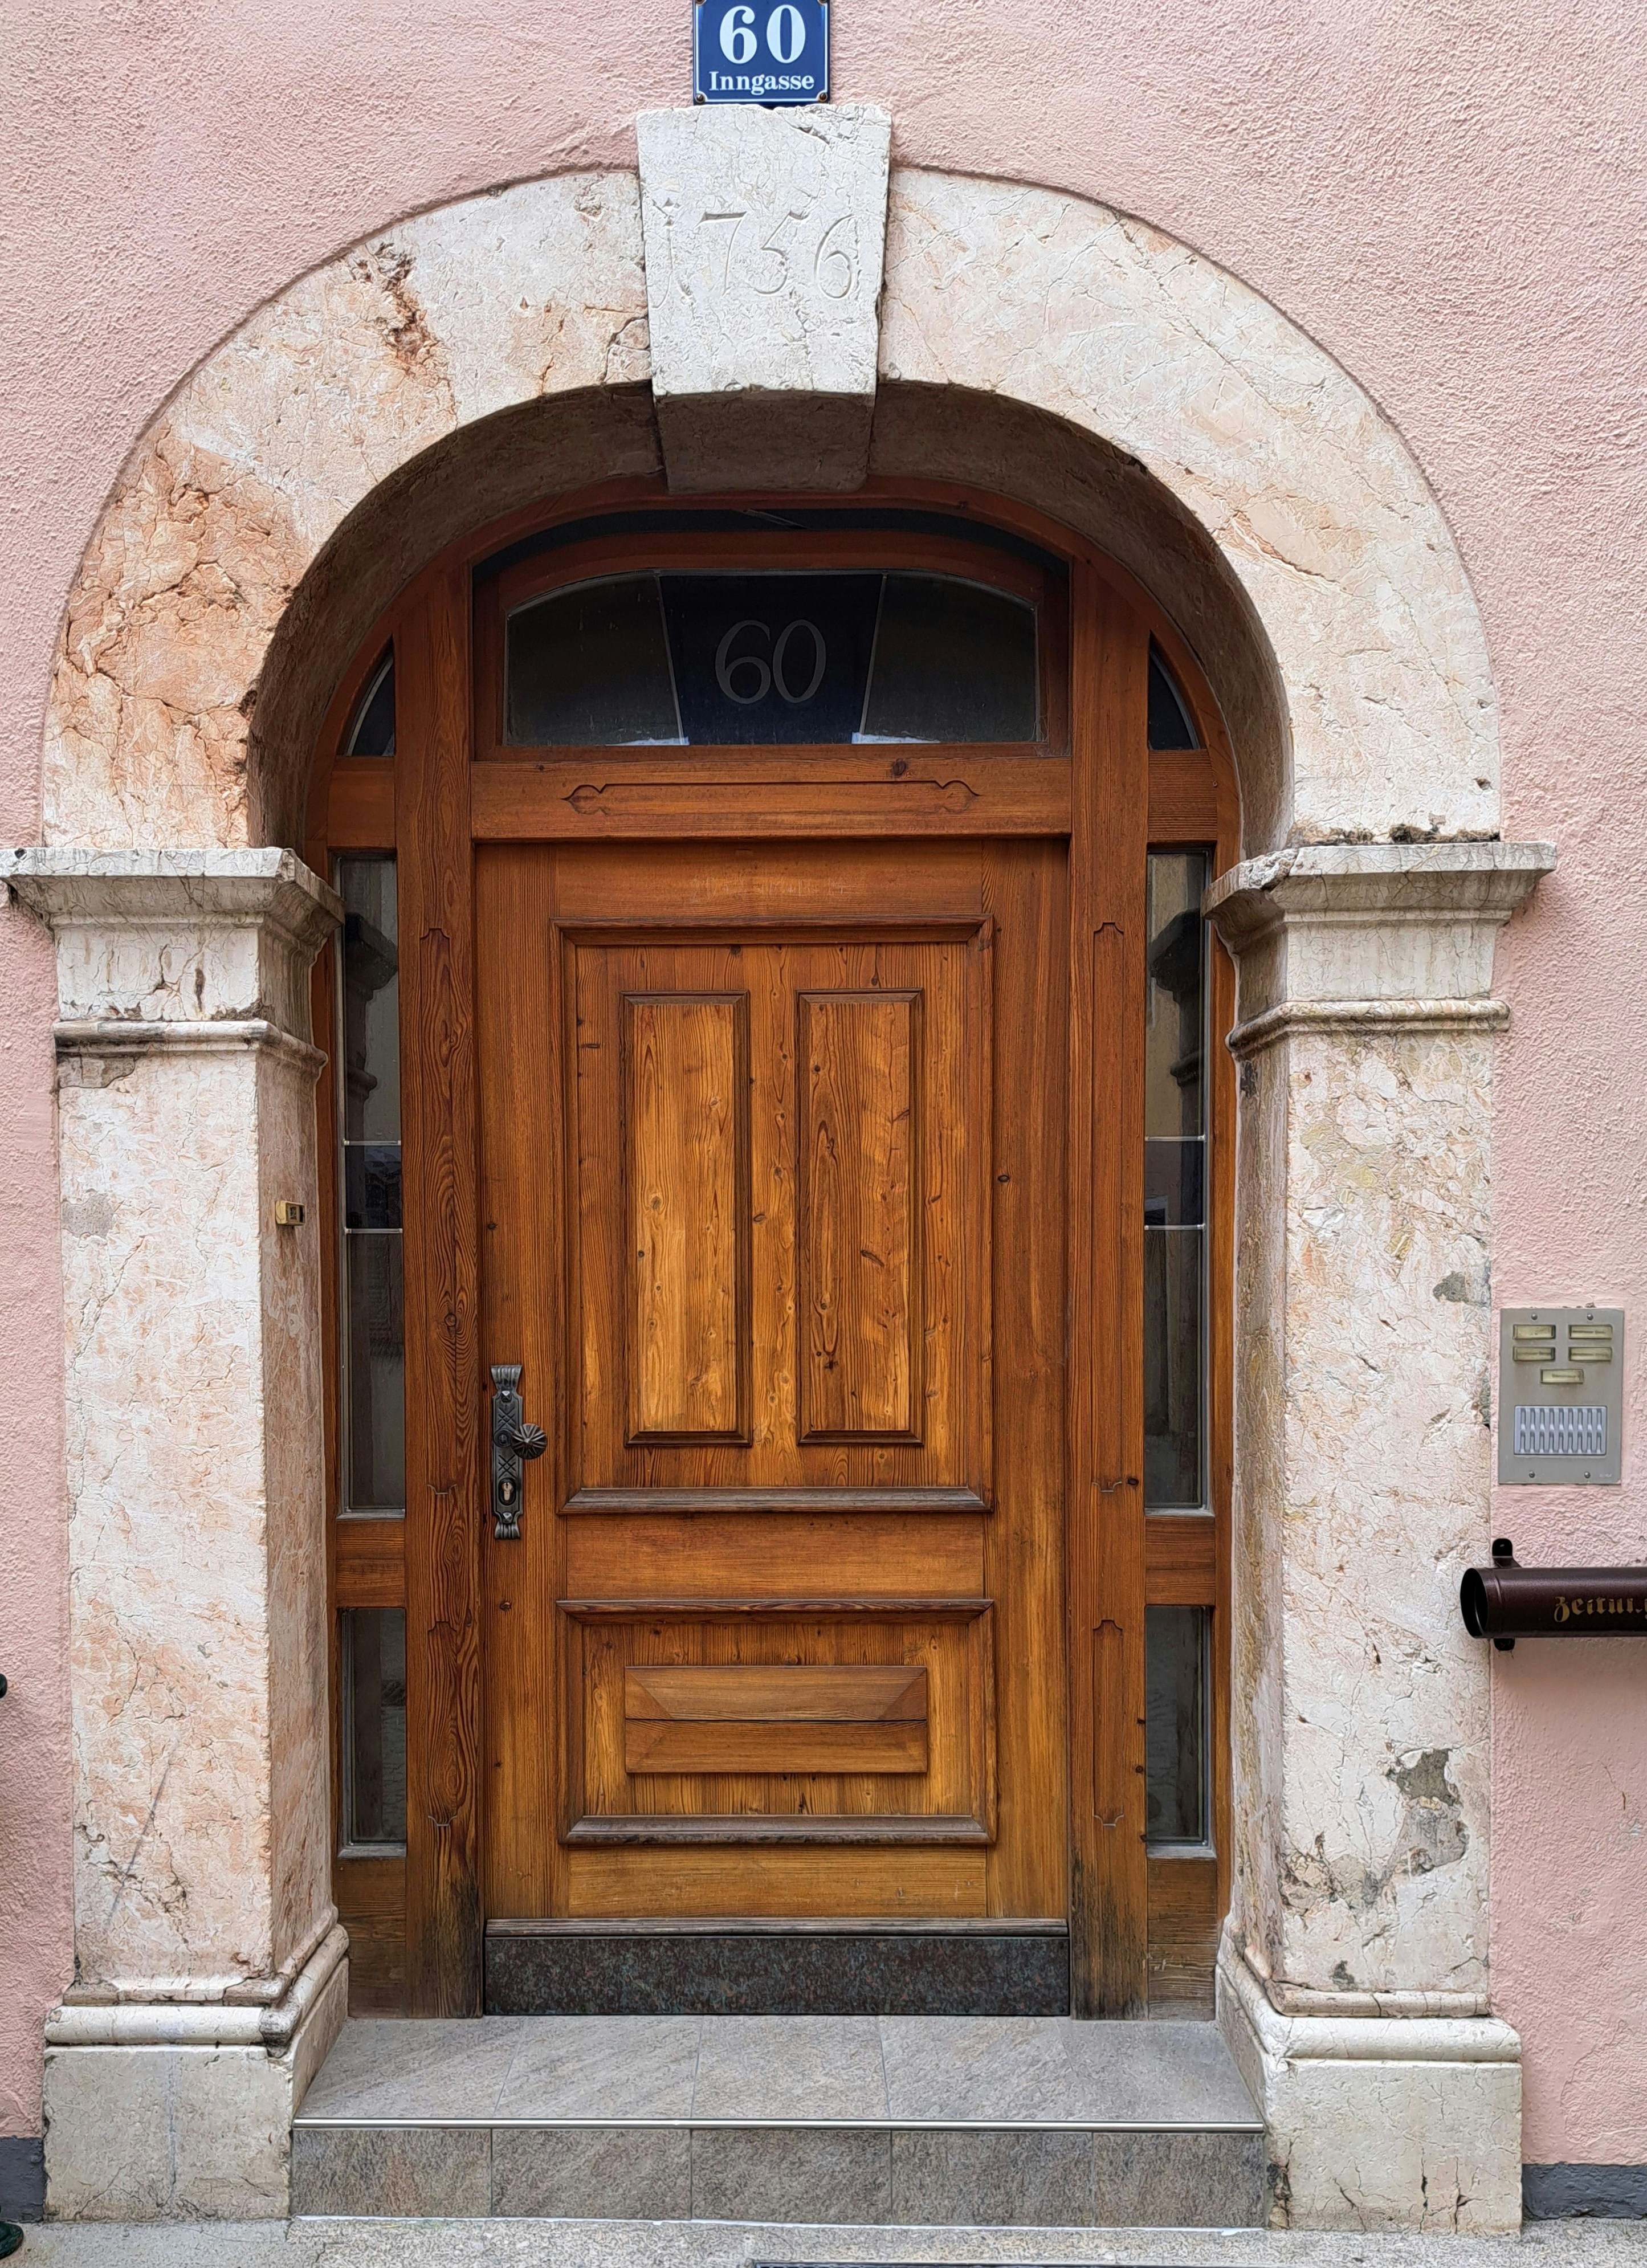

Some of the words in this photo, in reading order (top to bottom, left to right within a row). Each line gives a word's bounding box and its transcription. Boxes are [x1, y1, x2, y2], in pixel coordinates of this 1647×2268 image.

[720, 5, 805, 64] 60
[708, 71, 815, 95] Inngasse
[715, 619, 826, 704] 60
[1554, 1596, 1647, 1622] Zeitun
